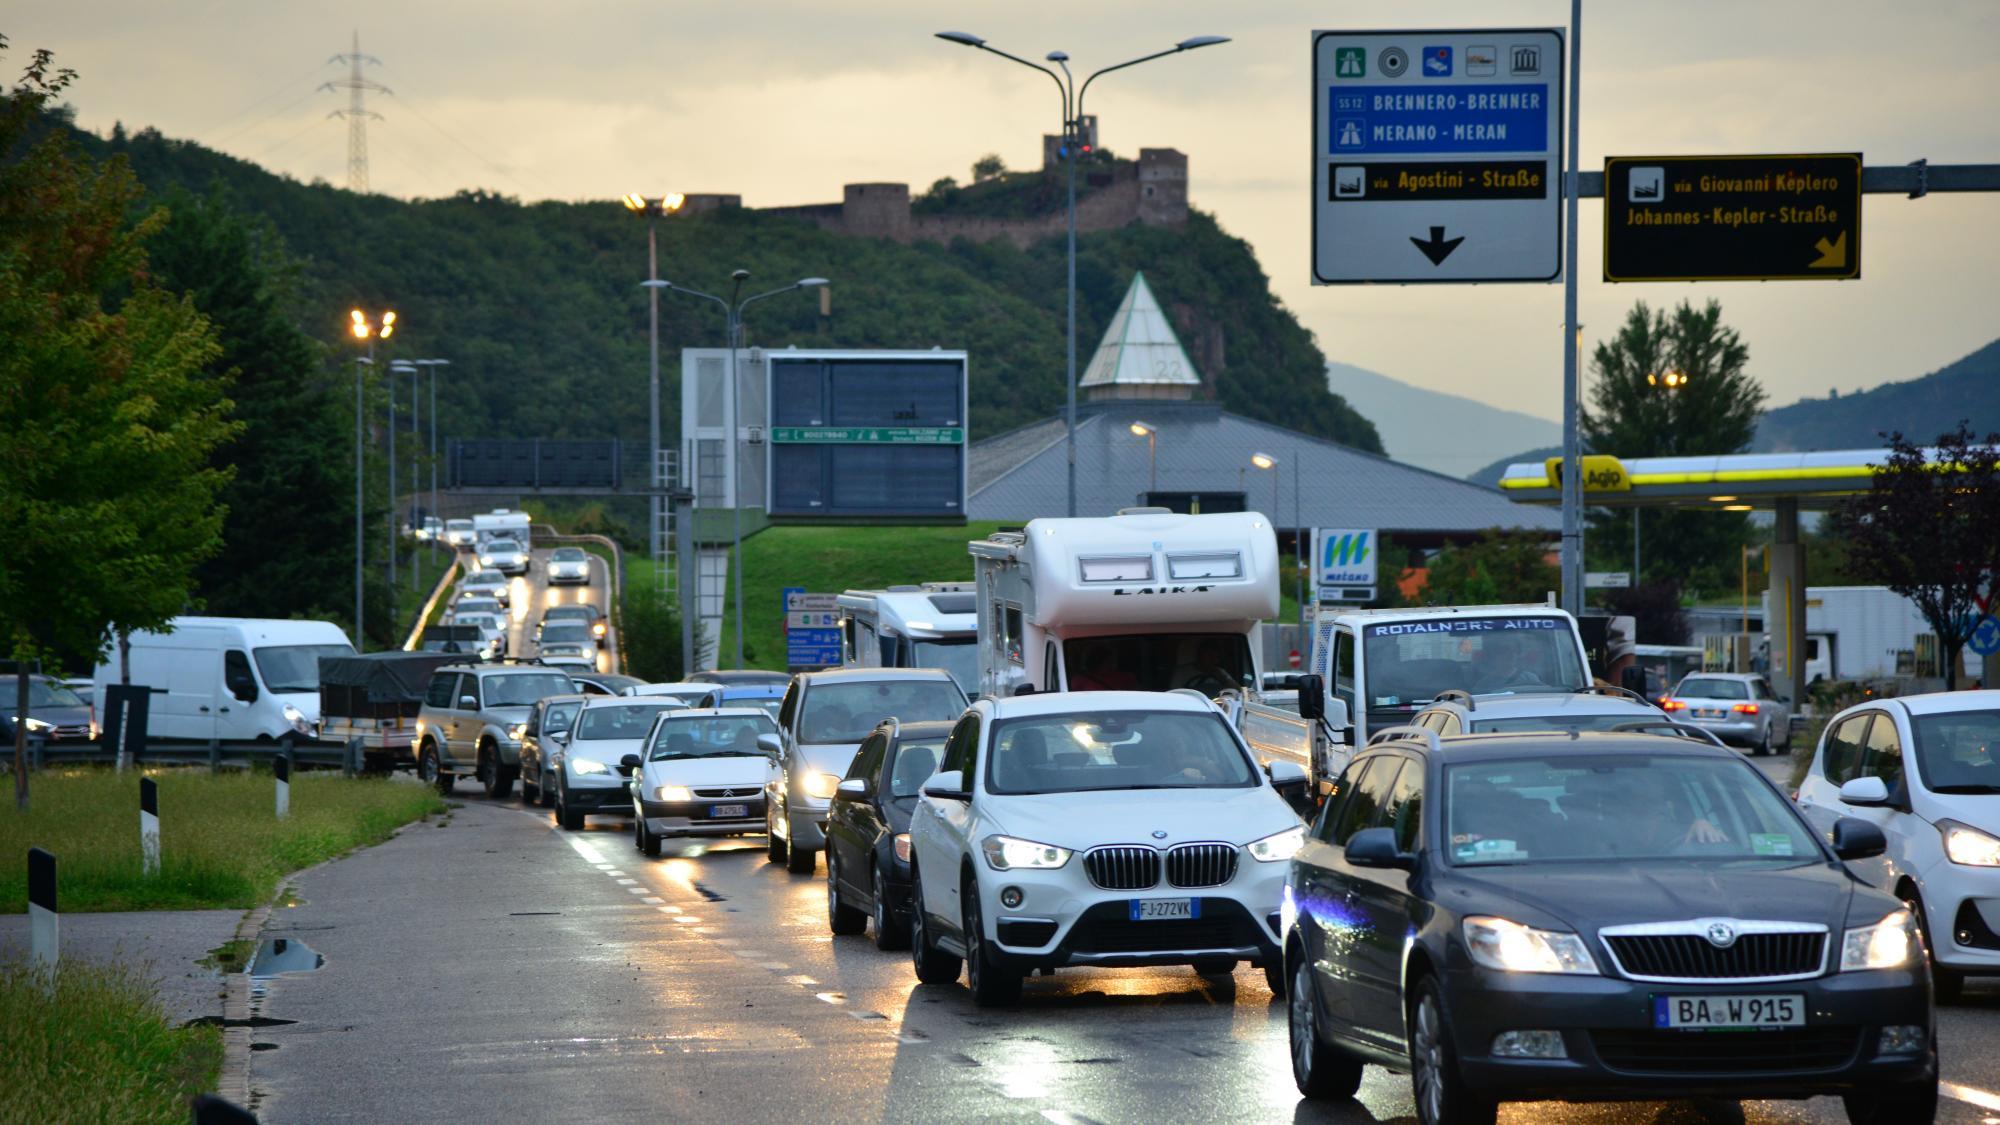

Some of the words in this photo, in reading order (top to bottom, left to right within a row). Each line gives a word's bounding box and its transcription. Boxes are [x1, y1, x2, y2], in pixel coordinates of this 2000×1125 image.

[1373, 125, 1437, 141] MERANO
[1454, 124, 1507, 140] MERAN
[1373, 179, 1389, 188] via
[1398, 171, 1463, 192] Agostini
[1483, 169, 1540, 188] Straße
[1674, 179, 1692, 193] via
[1700, 175, 1769, 192] Giovanni
[1776, 174, 1838, 195] Keplero
[1588, 468, 1621, 488] Agip
[1113, 585, 1216, 596] LAIKA
[1504, 619, 1555, 629] AUTO
[1678, 999, 1711, 1023] BA
